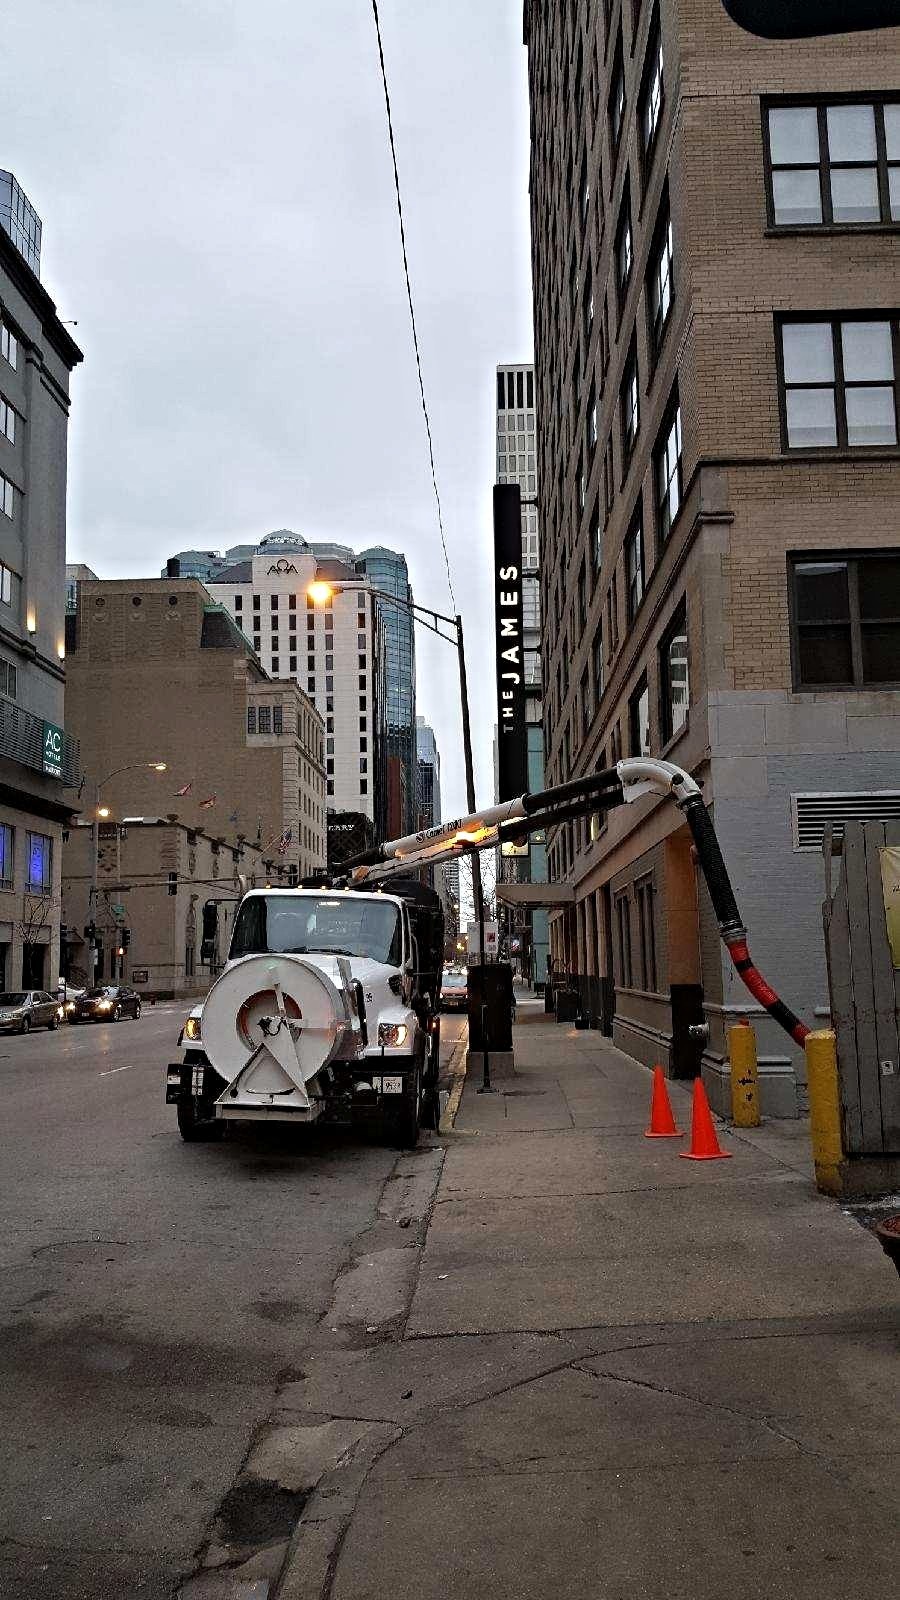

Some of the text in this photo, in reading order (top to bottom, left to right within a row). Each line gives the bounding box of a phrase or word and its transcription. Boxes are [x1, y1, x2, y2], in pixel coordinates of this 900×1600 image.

[500, 566, 520, 733] THE JAMES
[45, 730, 61, 752] AC
